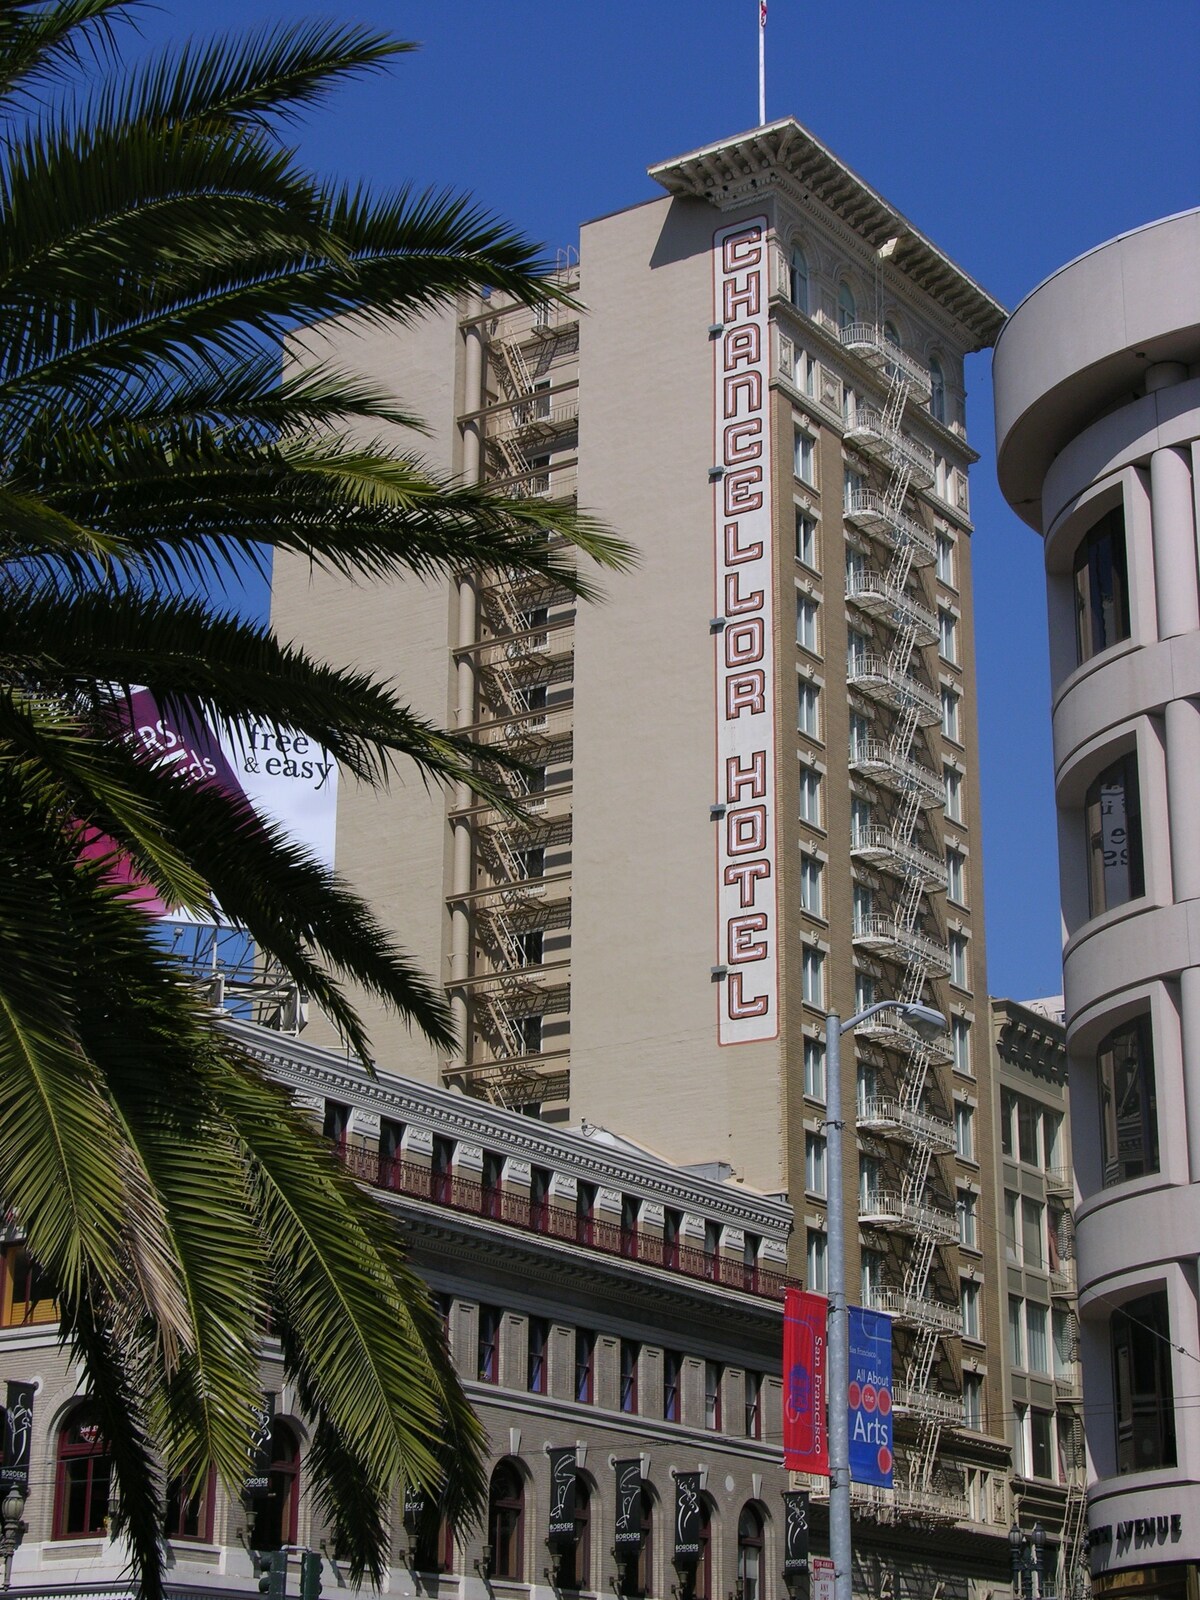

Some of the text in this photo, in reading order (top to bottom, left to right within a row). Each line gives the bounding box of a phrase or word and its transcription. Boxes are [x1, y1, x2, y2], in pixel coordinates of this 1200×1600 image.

[723, 226, 770, 1020] CHANCELLOR HOTEL
[248, 722, 309, 754] free
[244, 756, 334, 790] & easy
[856, 1368, 889, 1387] All About
[814, 1335, 823, 1455] San Francisco
[853, 1411, 888, 1446] Arts
[1, 1469, 27, 1479] BORDERS
[549, 1522, 574, 1531] BORDERS
[615, 1532, 640, 1540] BORDERS
[1116, 1514, 1181, 1541] AVENUE
[675, 1543, 699, 1551] BORDERS
[785, 1558, 807, 1566] BORDERS
